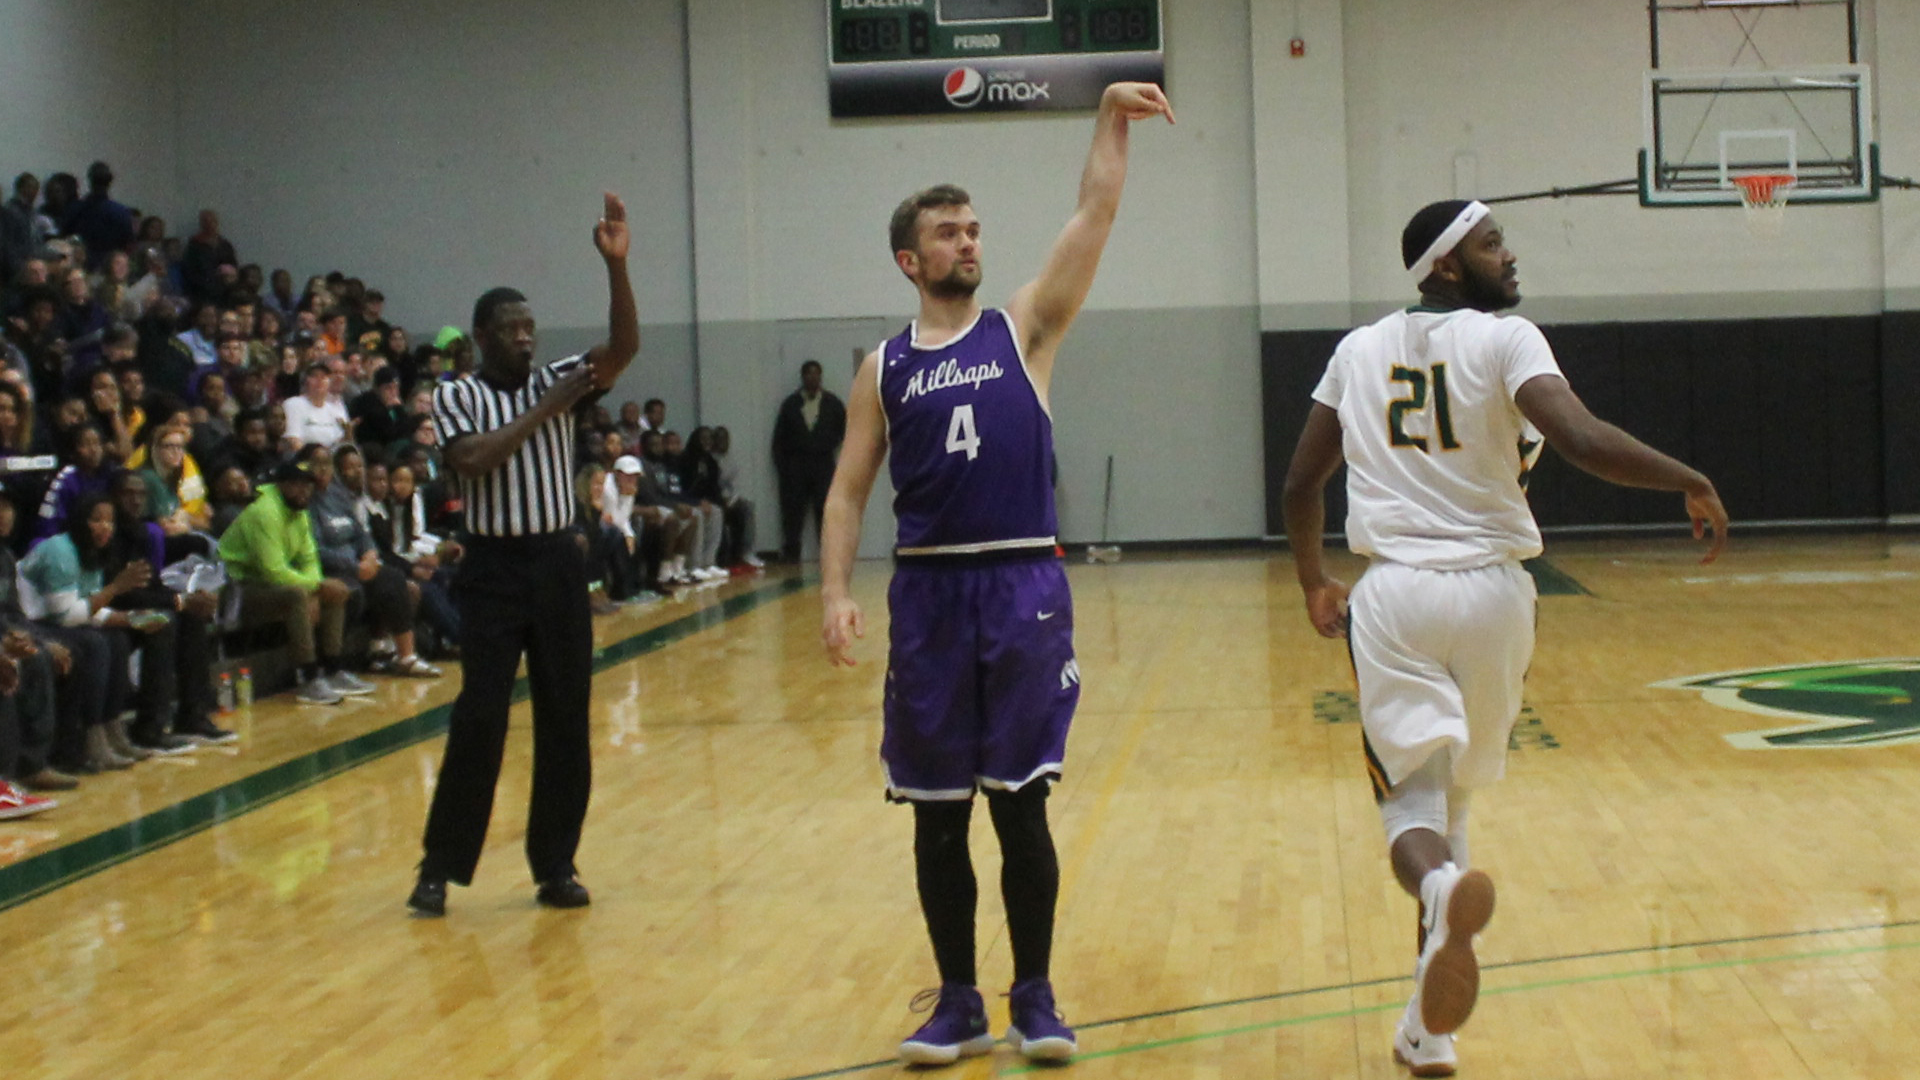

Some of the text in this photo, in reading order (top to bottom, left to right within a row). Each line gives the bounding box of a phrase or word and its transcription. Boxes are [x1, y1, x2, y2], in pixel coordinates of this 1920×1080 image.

[901, 357, 1004, 404] Millsaps
[1387, 362, 1461, 455] 21
[945, 403, 981, 461] 4
